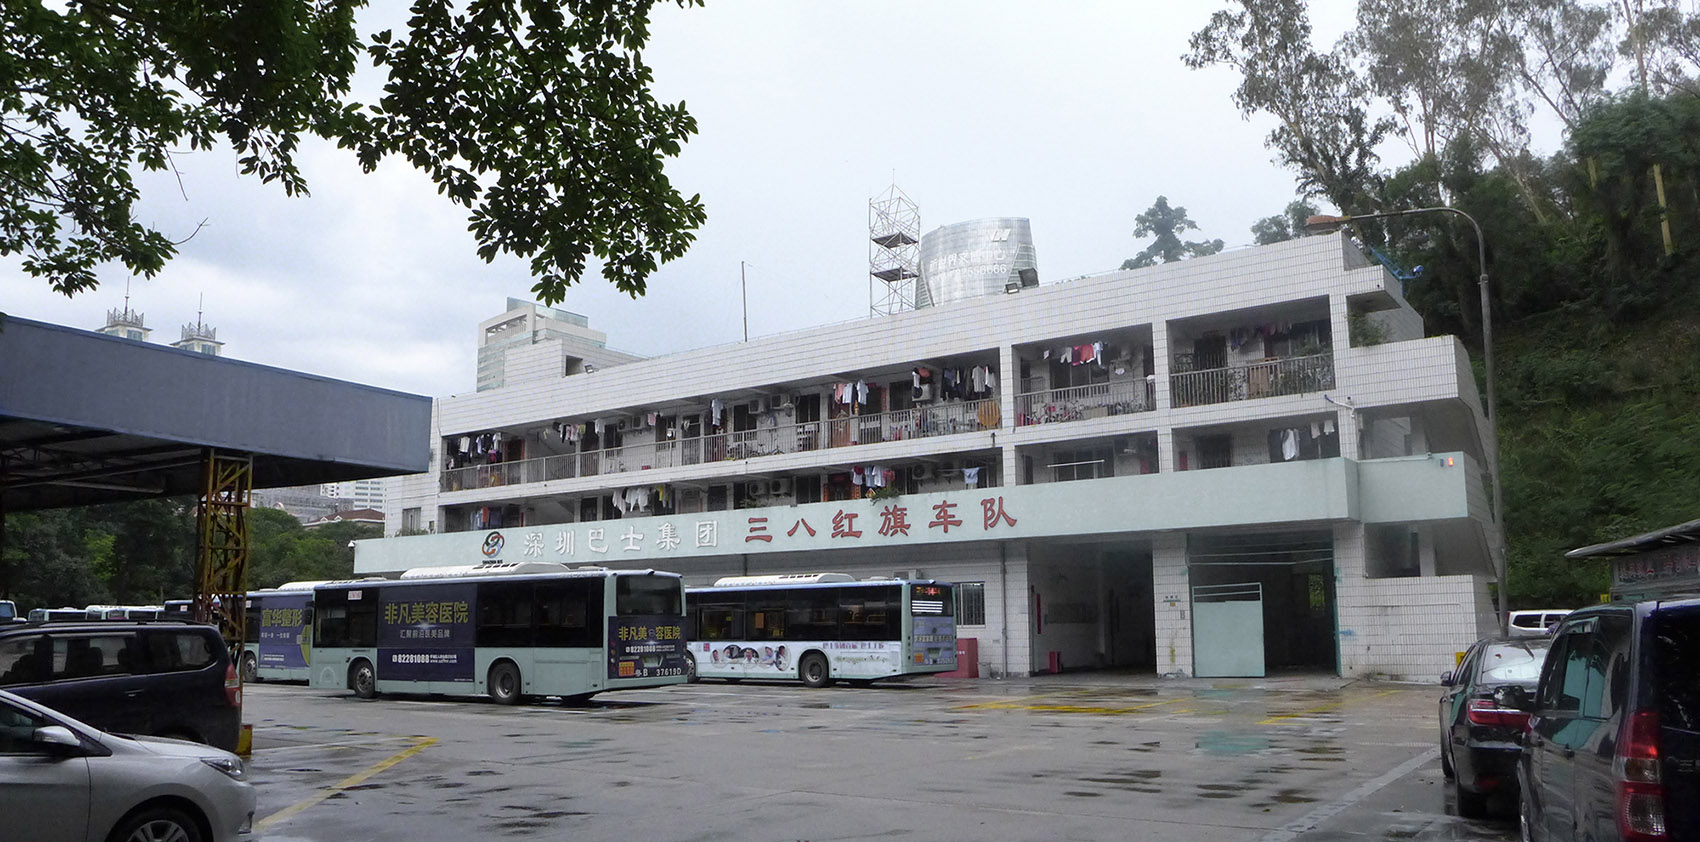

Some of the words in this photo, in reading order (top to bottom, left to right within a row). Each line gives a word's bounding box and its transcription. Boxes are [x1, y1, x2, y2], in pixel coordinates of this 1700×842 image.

[523, 520, 718, 557] 深圳巴士集团
[745, 496, 1017, 542] 三八红旗车队
[262, 608, 302, 627] 富华整形
[384, 601, 469, 624] 非凡美容医院
